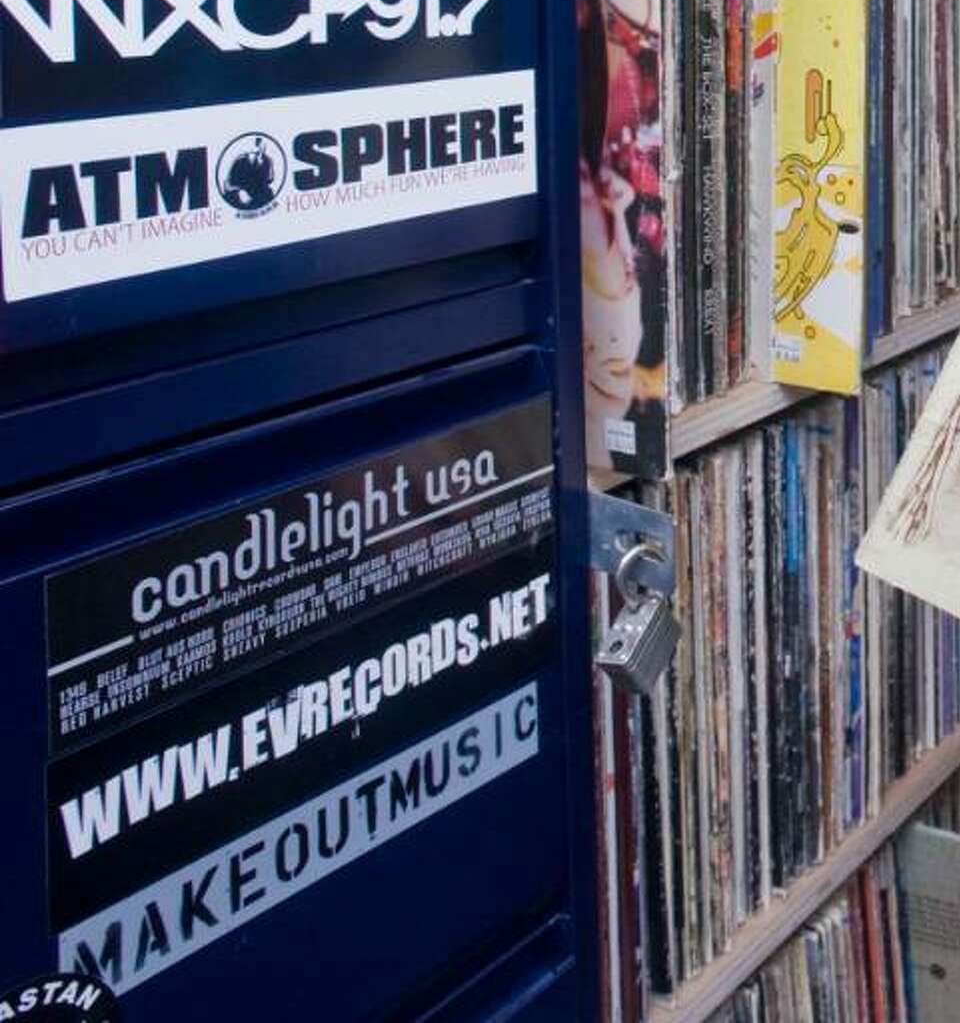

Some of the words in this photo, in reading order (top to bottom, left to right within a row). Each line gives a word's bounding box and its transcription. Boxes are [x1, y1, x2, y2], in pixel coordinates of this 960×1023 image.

[21, 235, 66, 261] YOU
[74, 222, 135, 253] CAN'T
[141, 207, 224, 240] IMAGINE
[285, 193, 331, 213] HOW
[335, 185, 386, 204] MUCH
[390, 175, 421, 194] FUN
[423, 165, 469, 188] WE'RE
[472, 158, 527, 179] HAVING
[131, 465, 410, 624] candlelight
[425, 448, 499, 505] usa
[74, 695, 537, 983] MAKEOUTMUSIC
